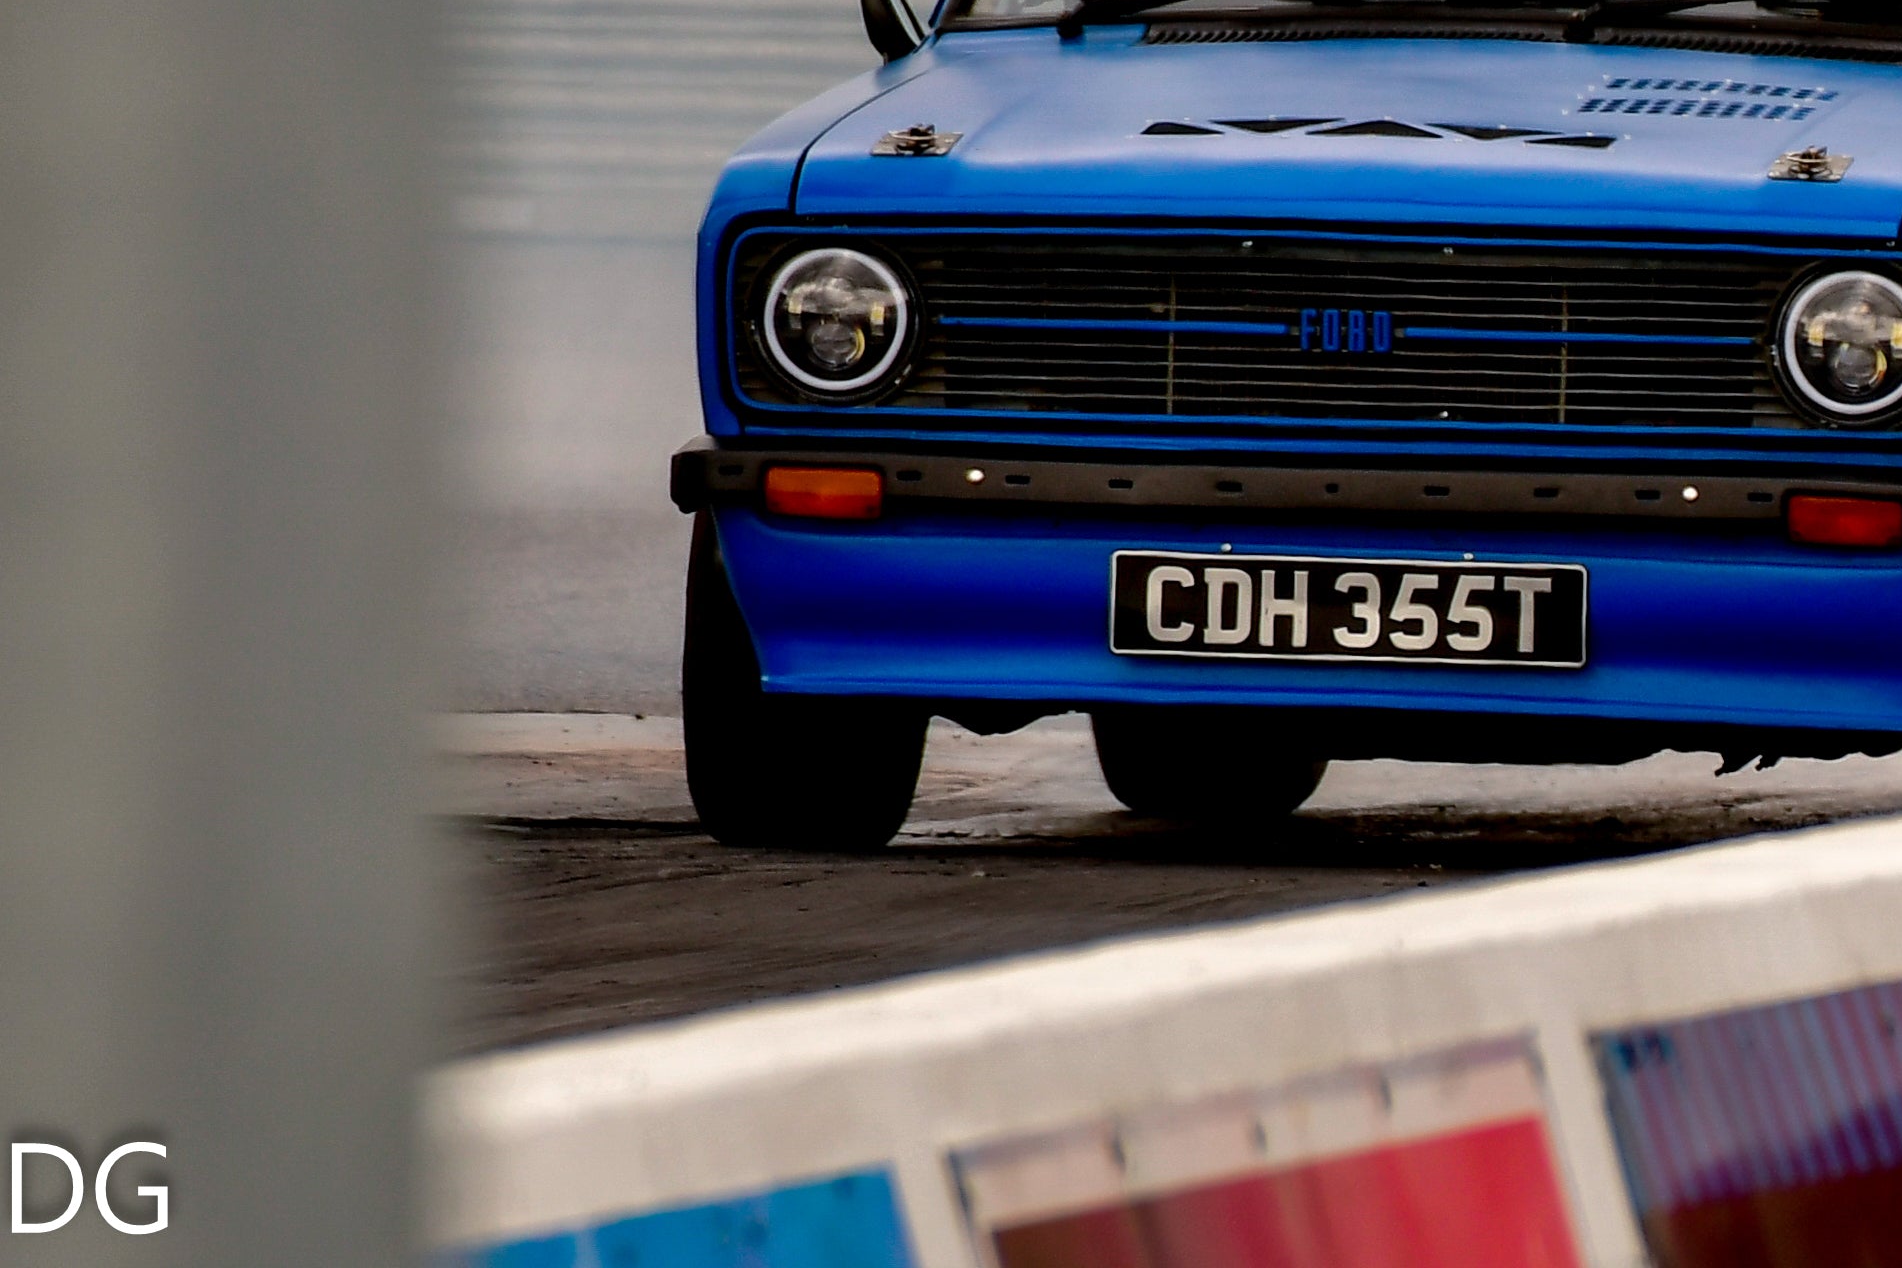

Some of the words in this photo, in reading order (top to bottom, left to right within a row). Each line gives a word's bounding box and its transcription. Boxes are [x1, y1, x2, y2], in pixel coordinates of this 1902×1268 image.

[1301, 308, 1392, 353] FORD
[1146, 565, 1309, 648] CDH
[1332, 572, 1553, 654] 355T
